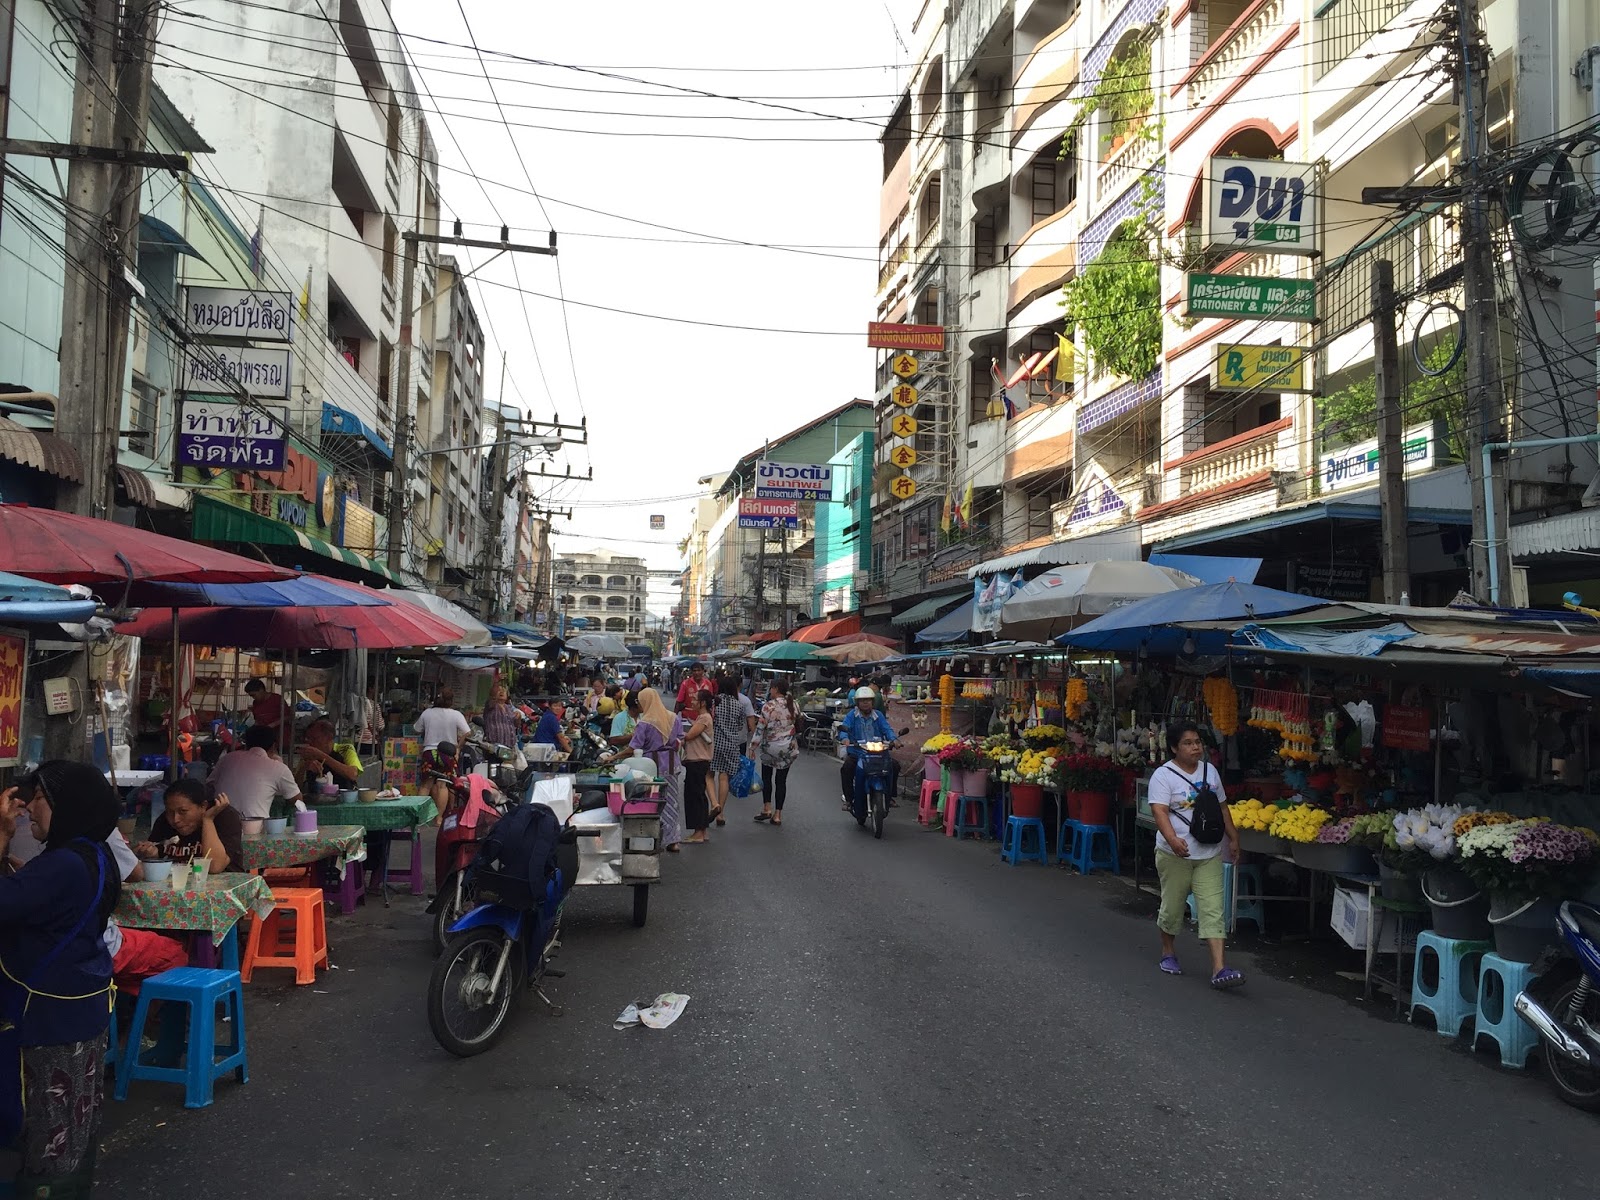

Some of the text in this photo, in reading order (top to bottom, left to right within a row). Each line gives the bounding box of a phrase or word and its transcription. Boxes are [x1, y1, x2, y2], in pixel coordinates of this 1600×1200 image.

[1192, 299, 1245, 311] STATIONERY
[1248, 302, 1257, 311] &
[187, 436, 274, 465] จัดฟัน
[760, 463, 830, 480] ข้าวต้ม
[804, 490, 817, 499] 24
